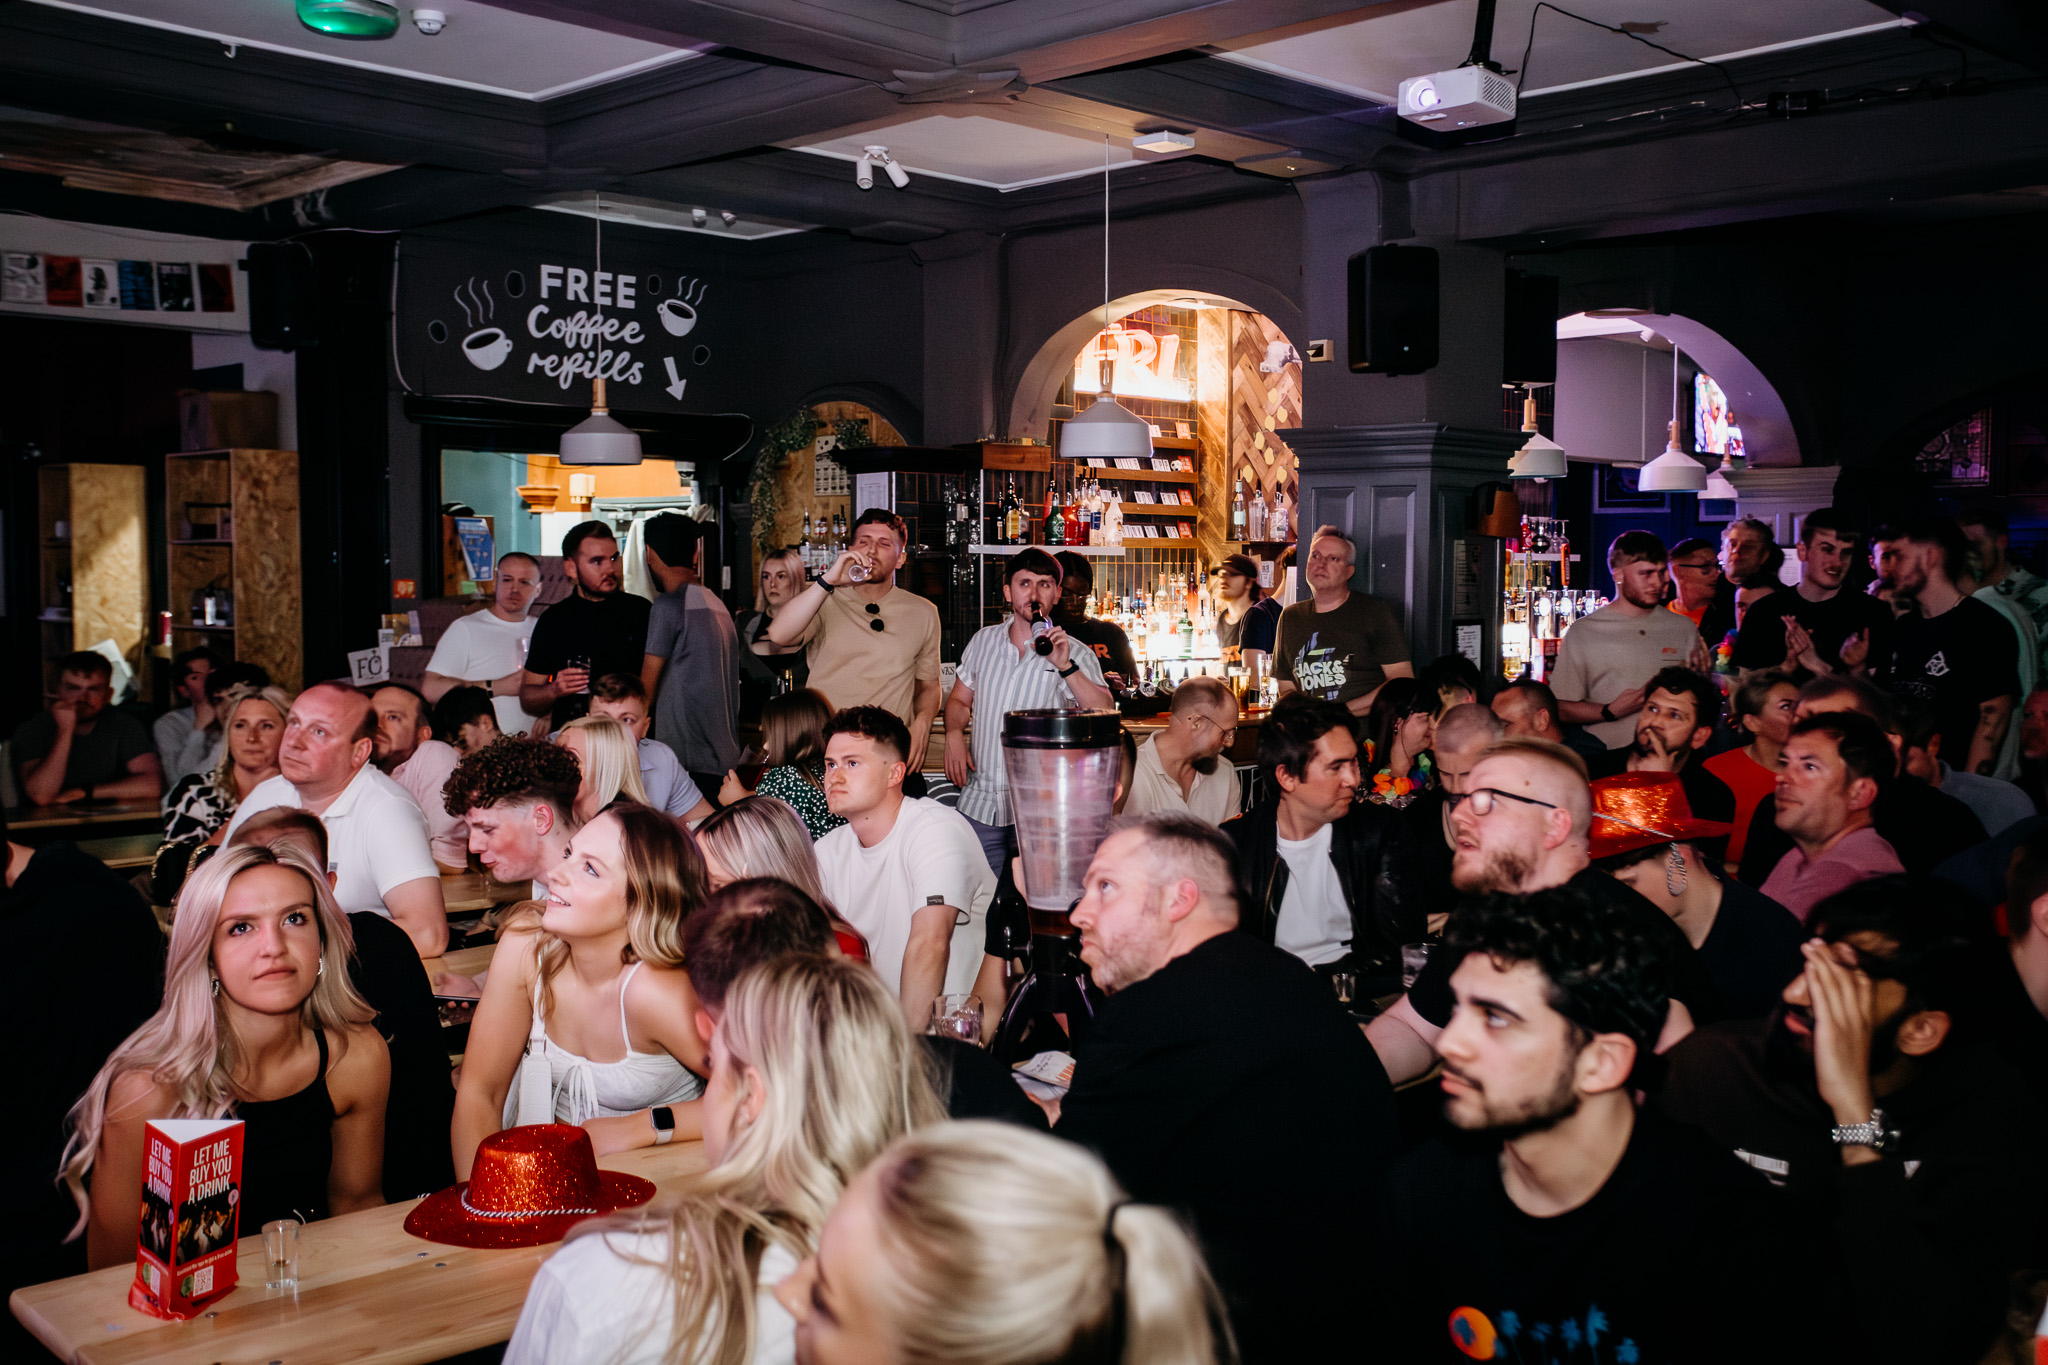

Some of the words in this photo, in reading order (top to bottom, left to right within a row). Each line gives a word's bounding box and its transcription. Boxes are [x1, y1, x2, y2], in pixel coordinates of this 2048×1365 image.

[540, 264, 636, 309] FREE
[527, 304, 645, 349] Coffee
[526, 349, 644, 390] refills
[189, 1163, 210, 1187] BUY
[212, 1155, 232, 1178] YOU
[193, 1144, 211, 1168] LET
[213, 1138, 230, 1160] ME
[187, 1187, 196, 1206] A
[197, 1173, 231, 1202] DRINK
